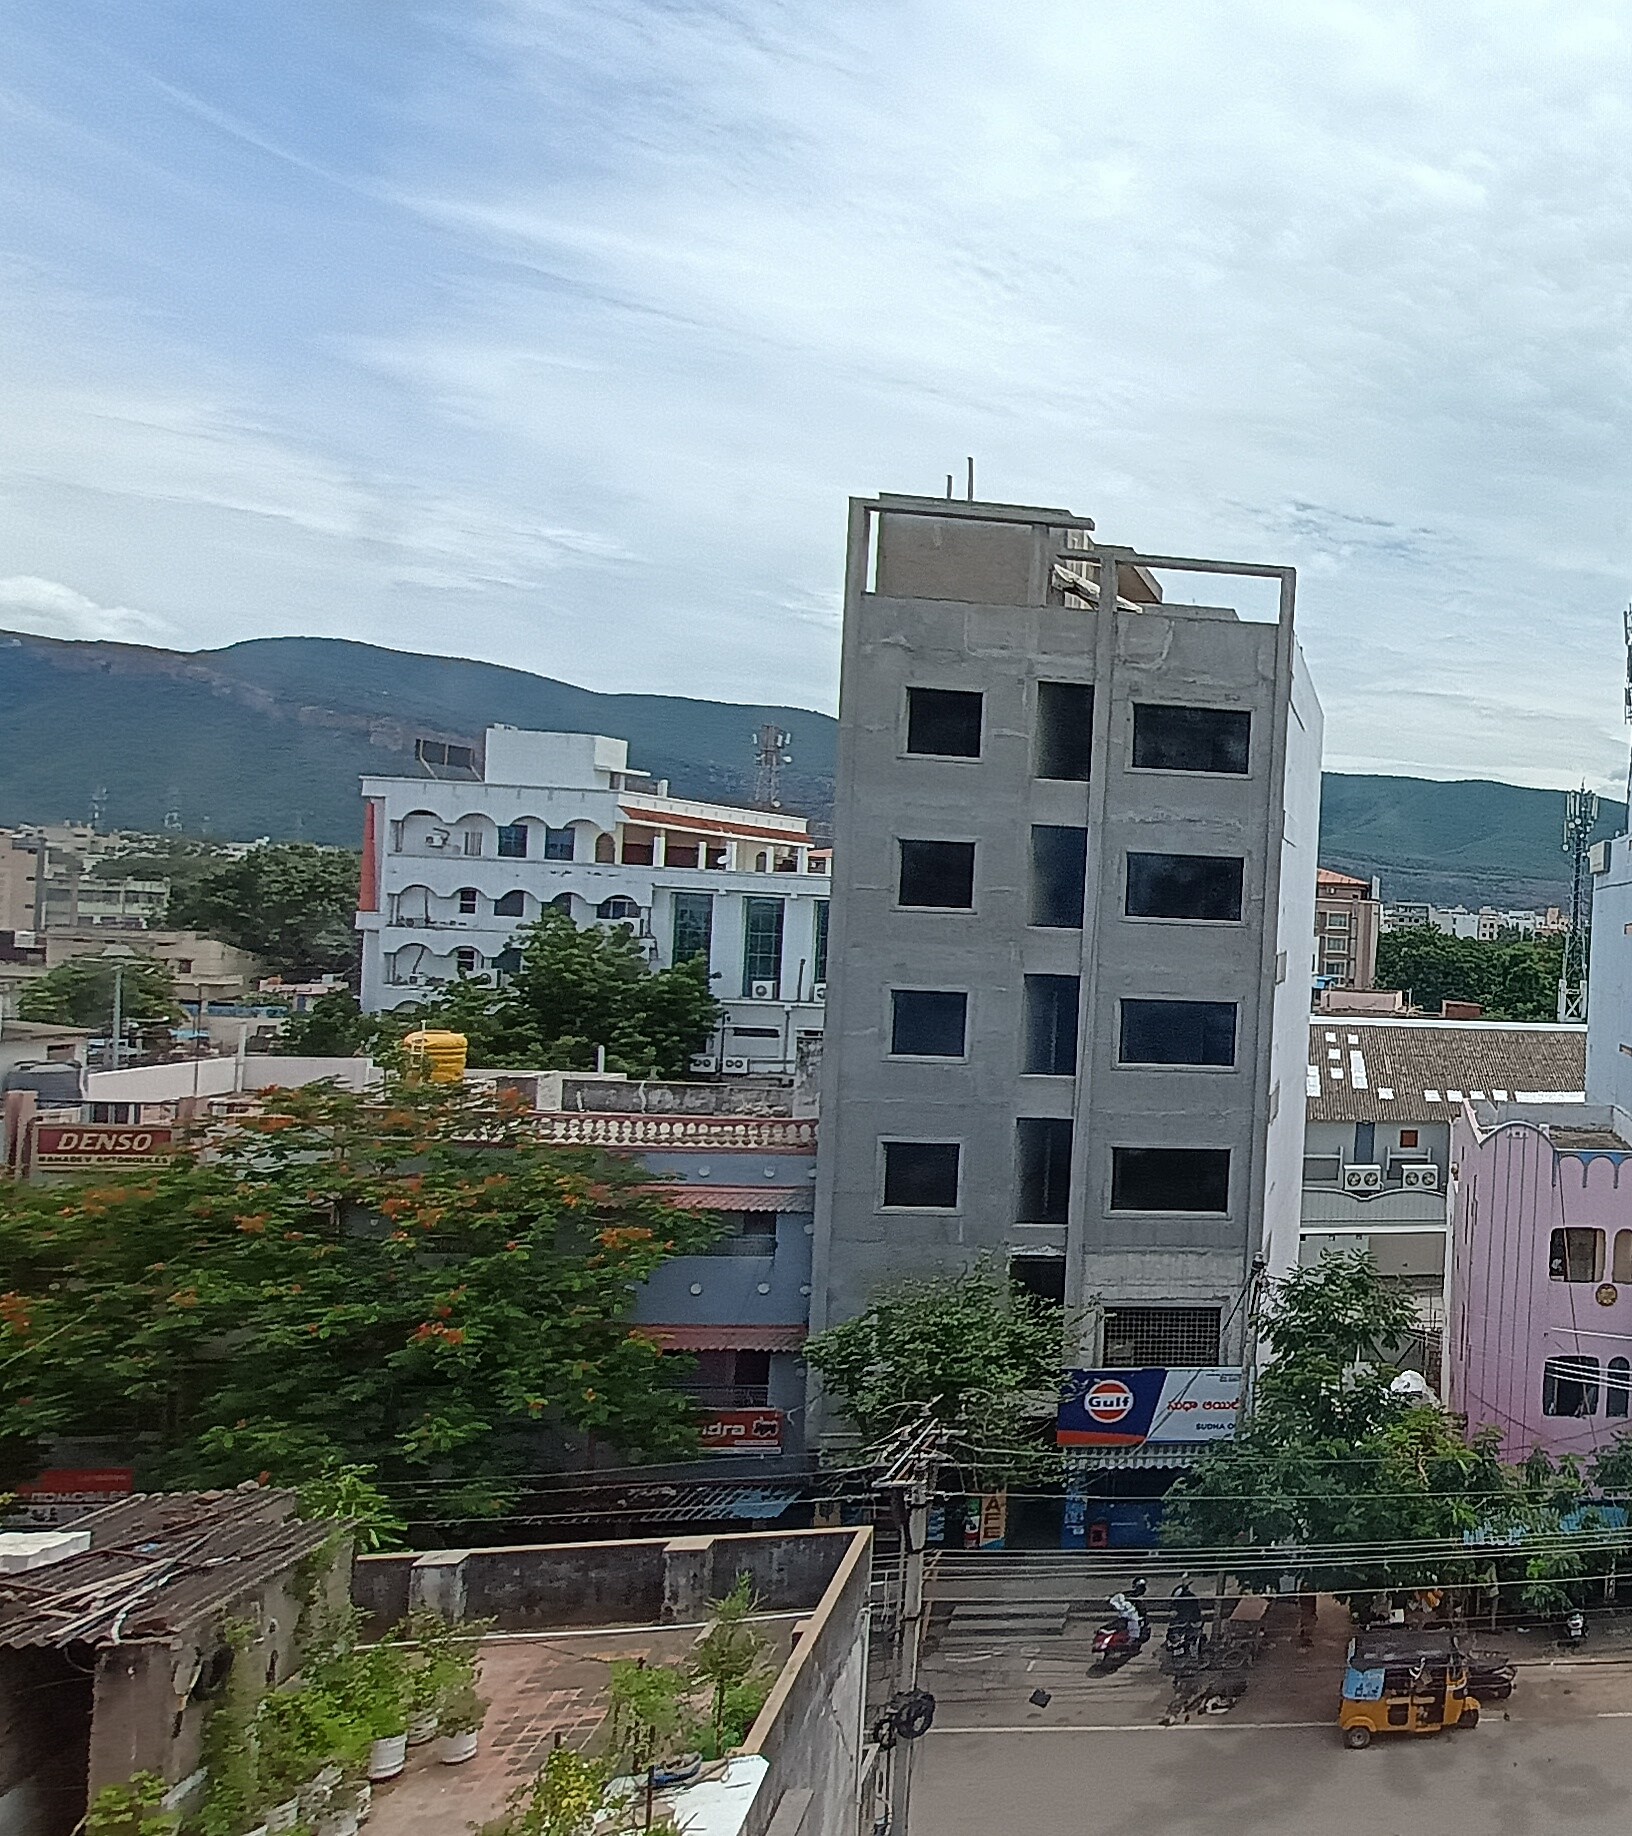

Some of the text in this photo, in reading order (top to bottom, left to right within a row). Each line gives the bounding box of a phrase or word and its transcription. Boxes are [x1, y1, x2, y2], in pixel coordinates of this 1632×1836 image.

[57, 1133, 152, 1151] DENSO
[1088, 1396, 1130, 1409] Gulf
[983, 1496, 1001, 1539] AFE
